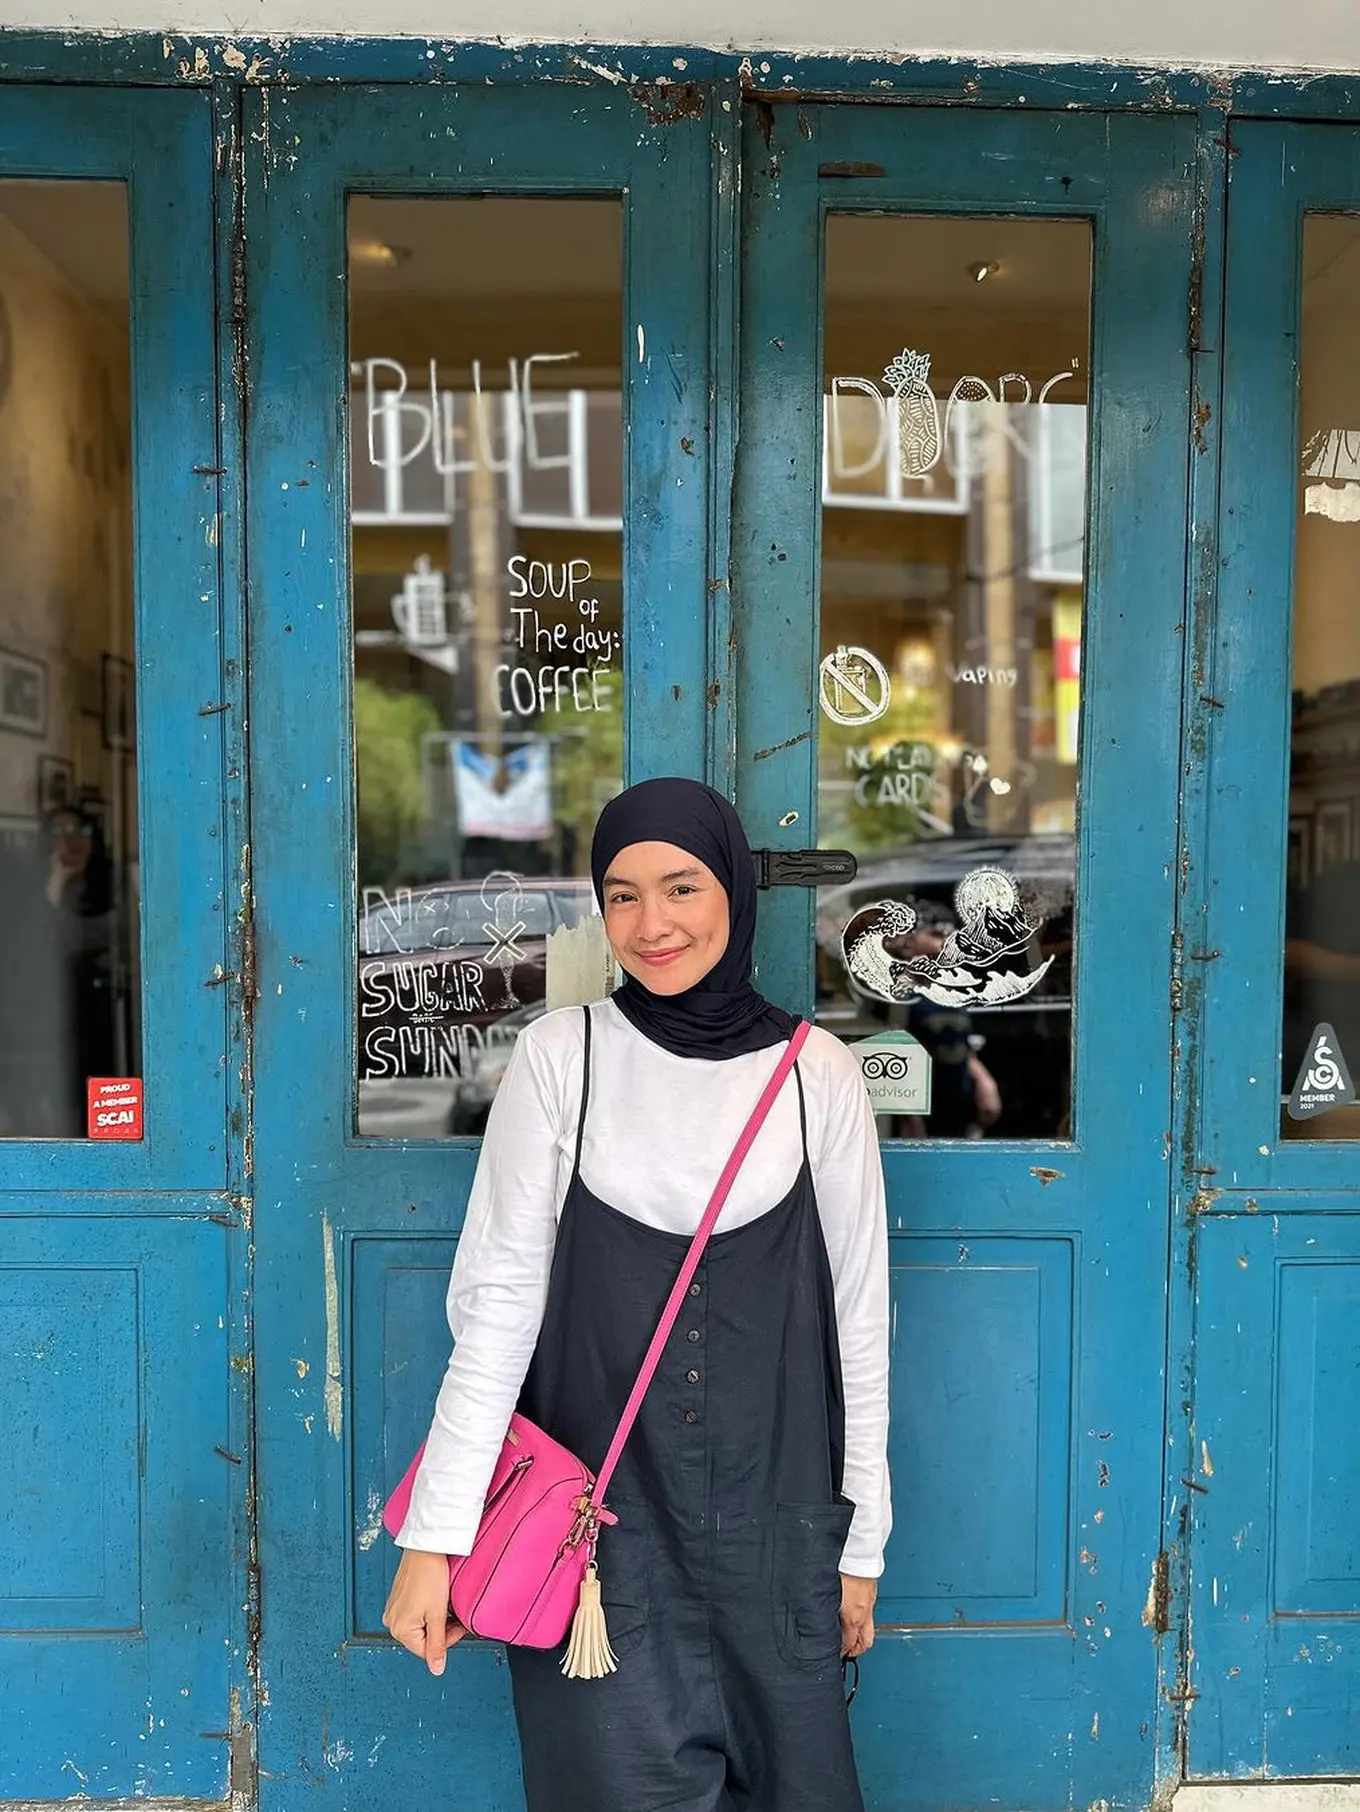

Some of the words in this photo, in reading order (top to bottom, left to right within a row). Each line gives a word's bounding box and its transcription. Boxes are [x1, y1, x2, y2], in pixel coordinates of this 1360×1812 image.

[507, 555, 592, 602] SOUP
[579, 598, 599, 623] of
[510, 608, 568, 653] The
[573, 624, 621, 662] day:
[491, 664, 613, 719] COFFEE
[361, 961, 488, 1017] SUGAR
[365, 1023, 519, 1083] SUND
[100, 1084, 130, 1093] PROUD
[866, 1085, 918, 1099] advisor
[1299, 1093, 1336, 1103] MEMBER
[101, 1096, 137, 1107] MEMBER
[97, 1110, 134, 1126] SCAI
